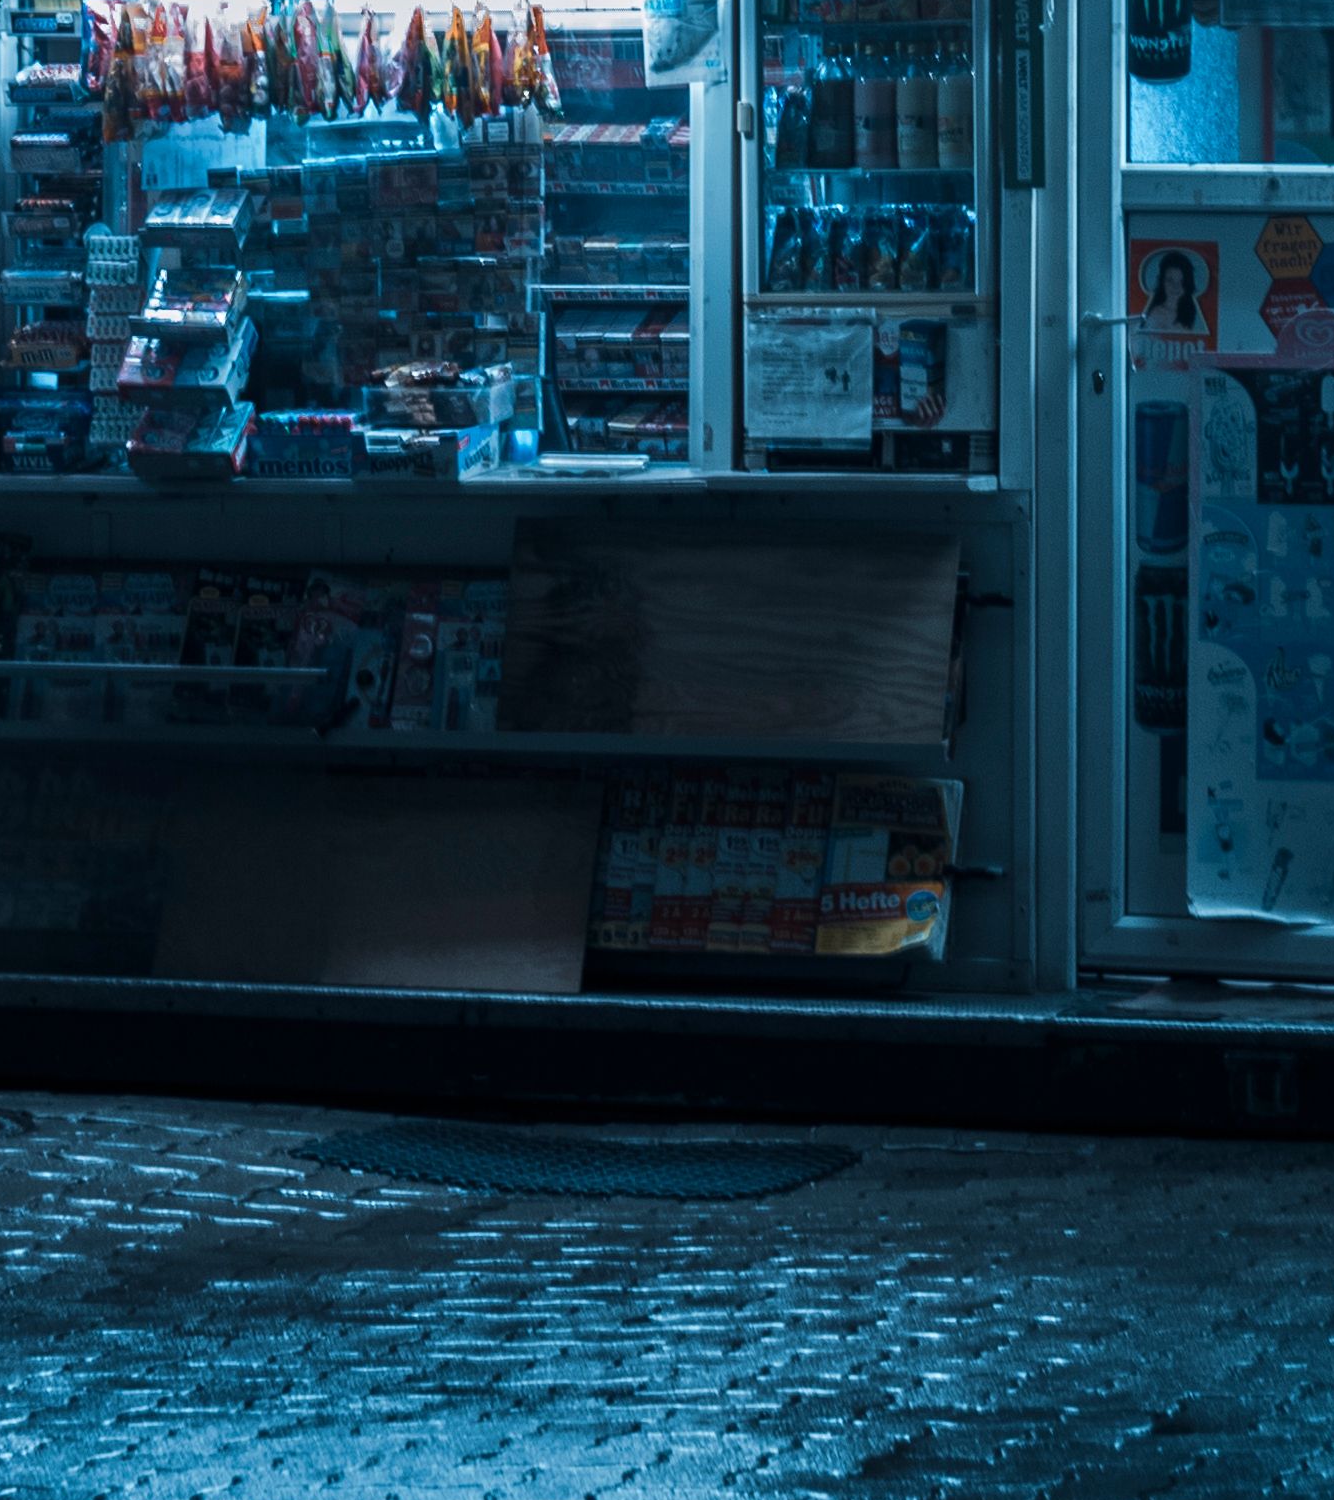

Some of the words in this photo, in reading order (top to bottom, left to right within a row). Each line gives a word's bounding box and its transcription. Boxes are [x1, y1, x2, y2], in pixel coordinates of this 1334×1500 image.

[1273, 222, 1303, 236] Wir
[1262, 238, 1319, 254] fragen
[1268, 252, 1313, 270] nach!
[12, 455, 53, 470] VIVIL
[258, 456, 351, 476] mentos
[820, 893, 835, 914] 5
[839, 891, 901, 911] Hefte
